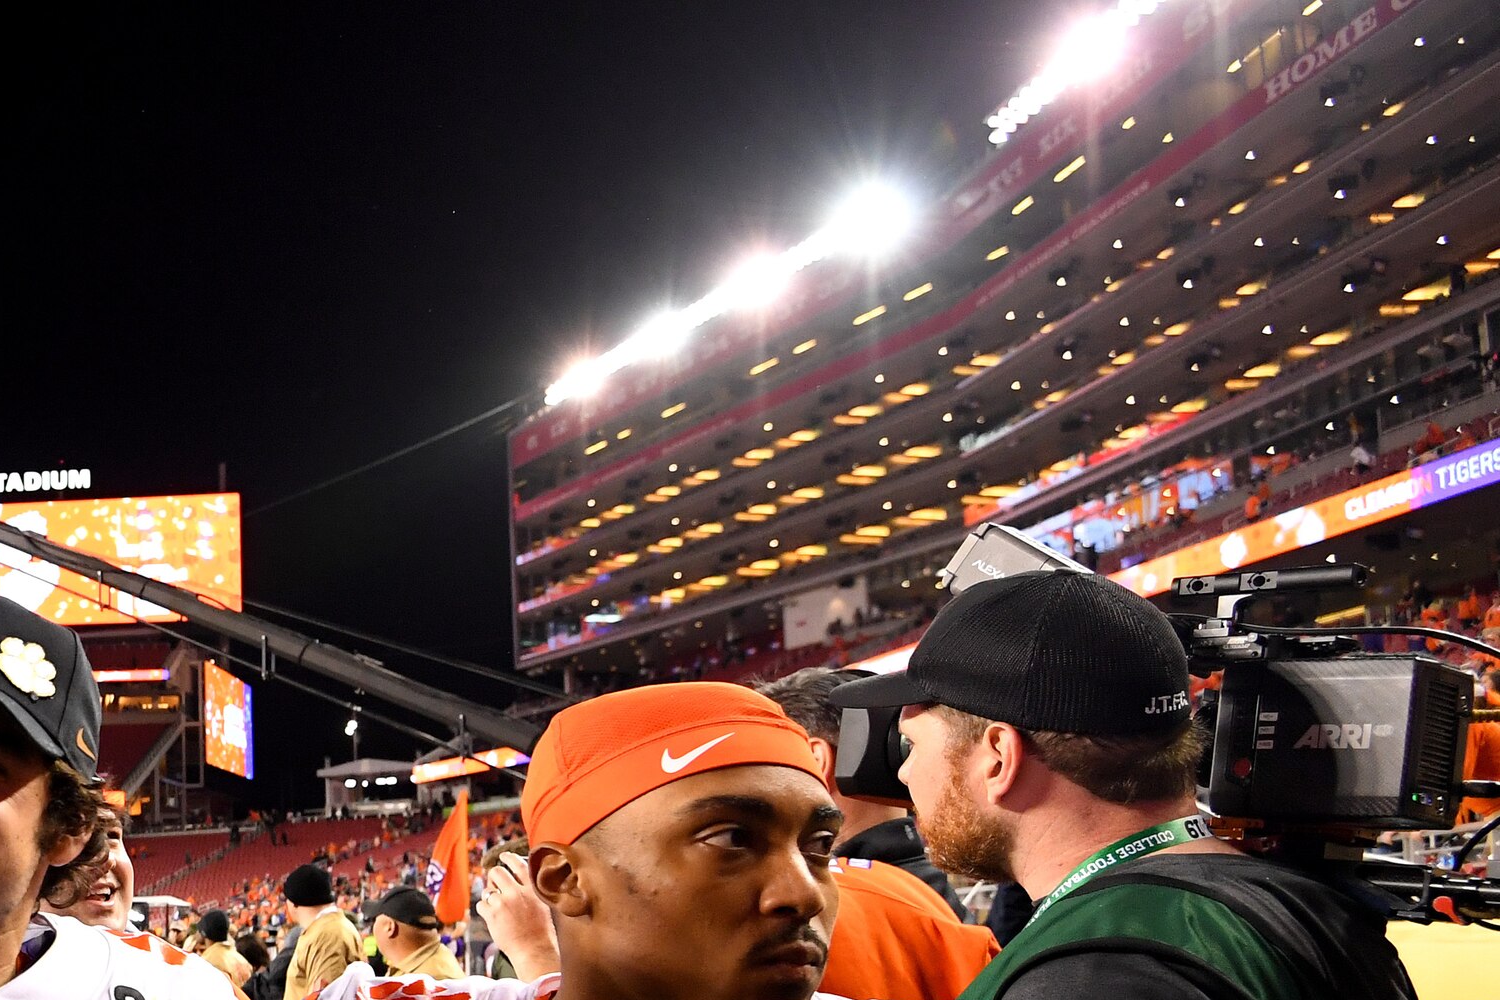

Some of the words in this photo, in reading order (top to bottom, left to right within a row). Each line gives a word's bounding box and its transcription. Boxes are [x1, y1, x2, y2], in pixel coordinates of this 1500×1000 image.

[1264, 7, 1378, 103] HOME
[1435, 446, 1500, 490] TIGERS
[1293, 723, 1373, 749] ARRI
[1116, 830, 1175, 859] COLLEGE
[1184, 819, 1205, 839] 19
[1051, 853, 1117, 898] FOOTBALL
